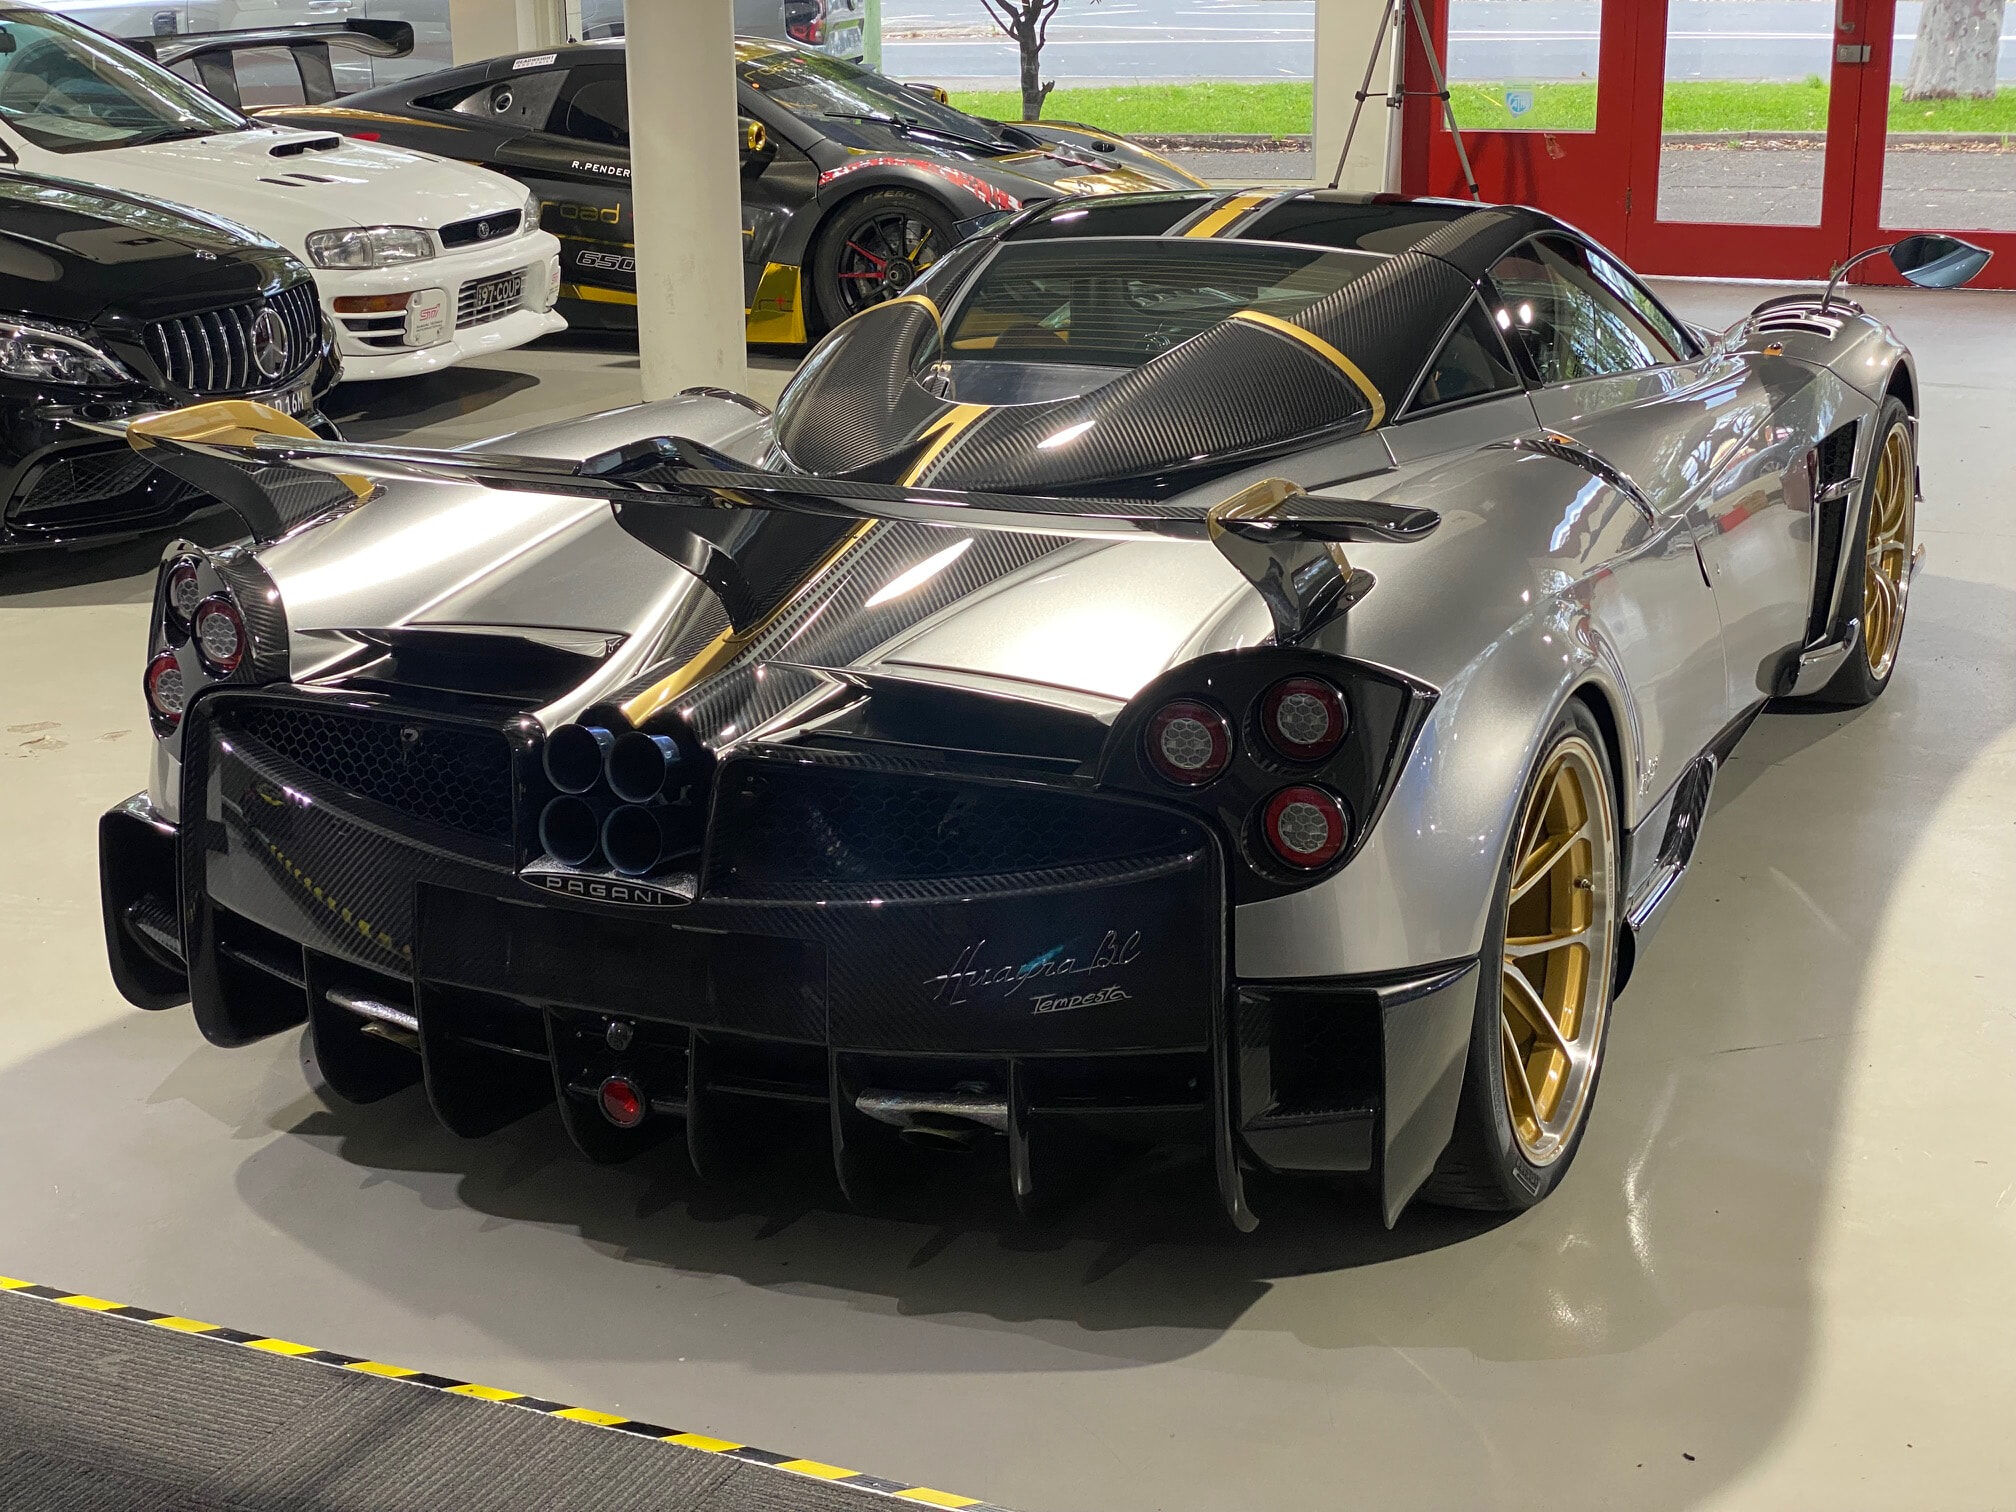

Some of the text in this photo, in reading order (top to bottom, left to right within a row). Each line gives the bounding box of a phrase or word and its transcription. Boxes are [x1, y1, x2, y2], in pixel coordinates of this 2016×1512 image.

[571, 160, 632, 178] R.PENDER
[546, 876, 662, 904] PAGANI
[922, 939, 1084, 1005] Huayra
[1029, 984, 1133, 1015] Tempesta
